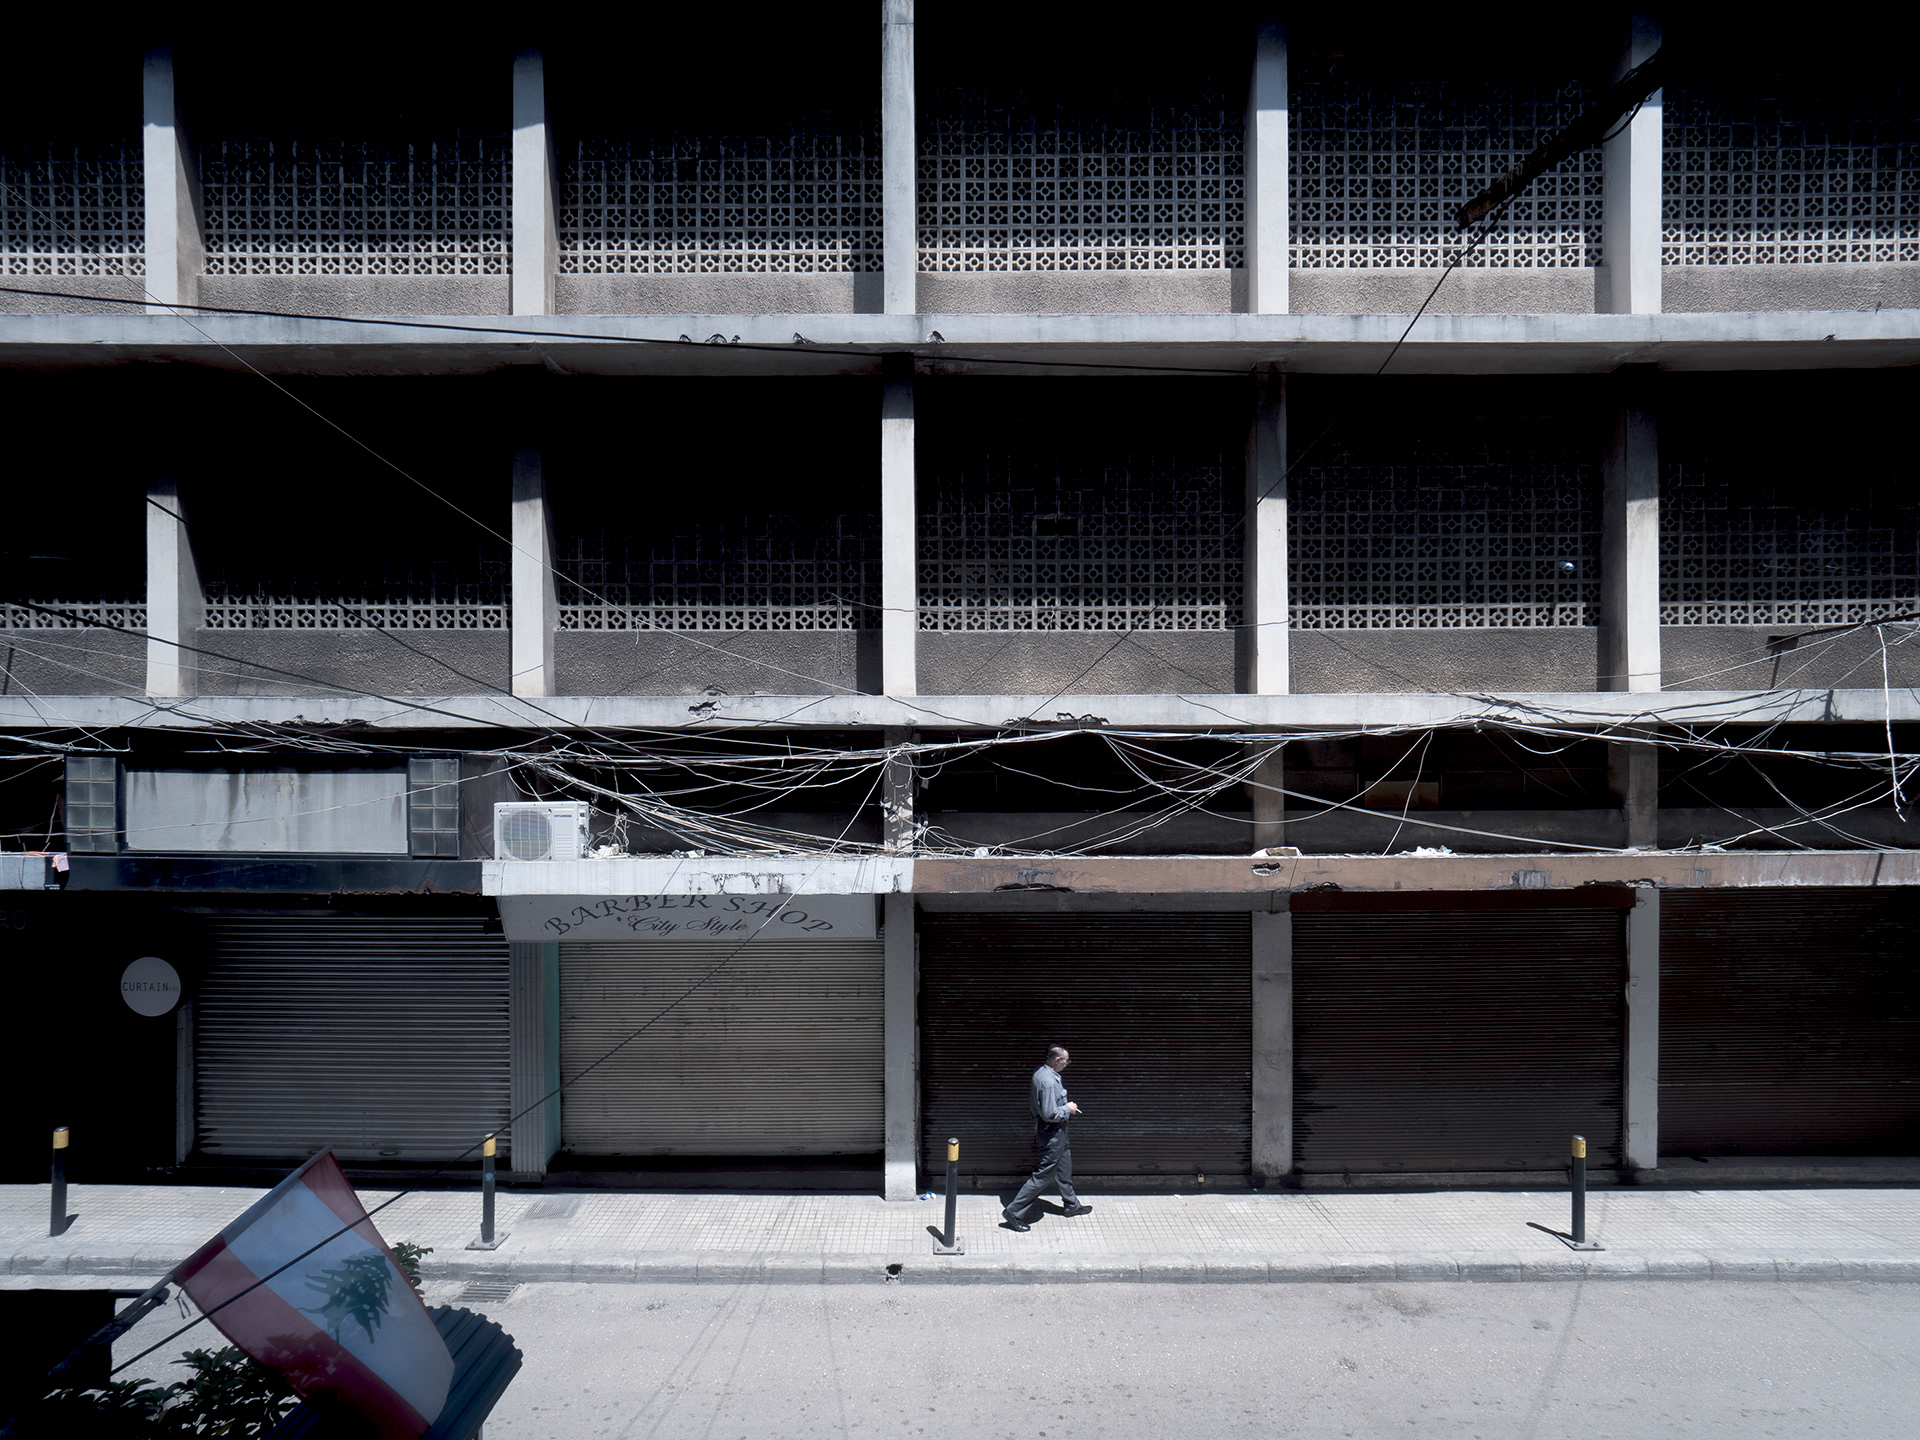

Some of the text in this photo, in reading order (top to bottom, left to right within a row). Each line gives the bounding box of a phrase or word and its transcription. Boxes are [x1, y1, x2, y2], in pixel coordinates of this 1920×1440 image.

[543, 894, 834, 935] BARBER SHOP
[628, 915, 748, 936] City Style
[122, 981, 169, 992] CURTAIN
